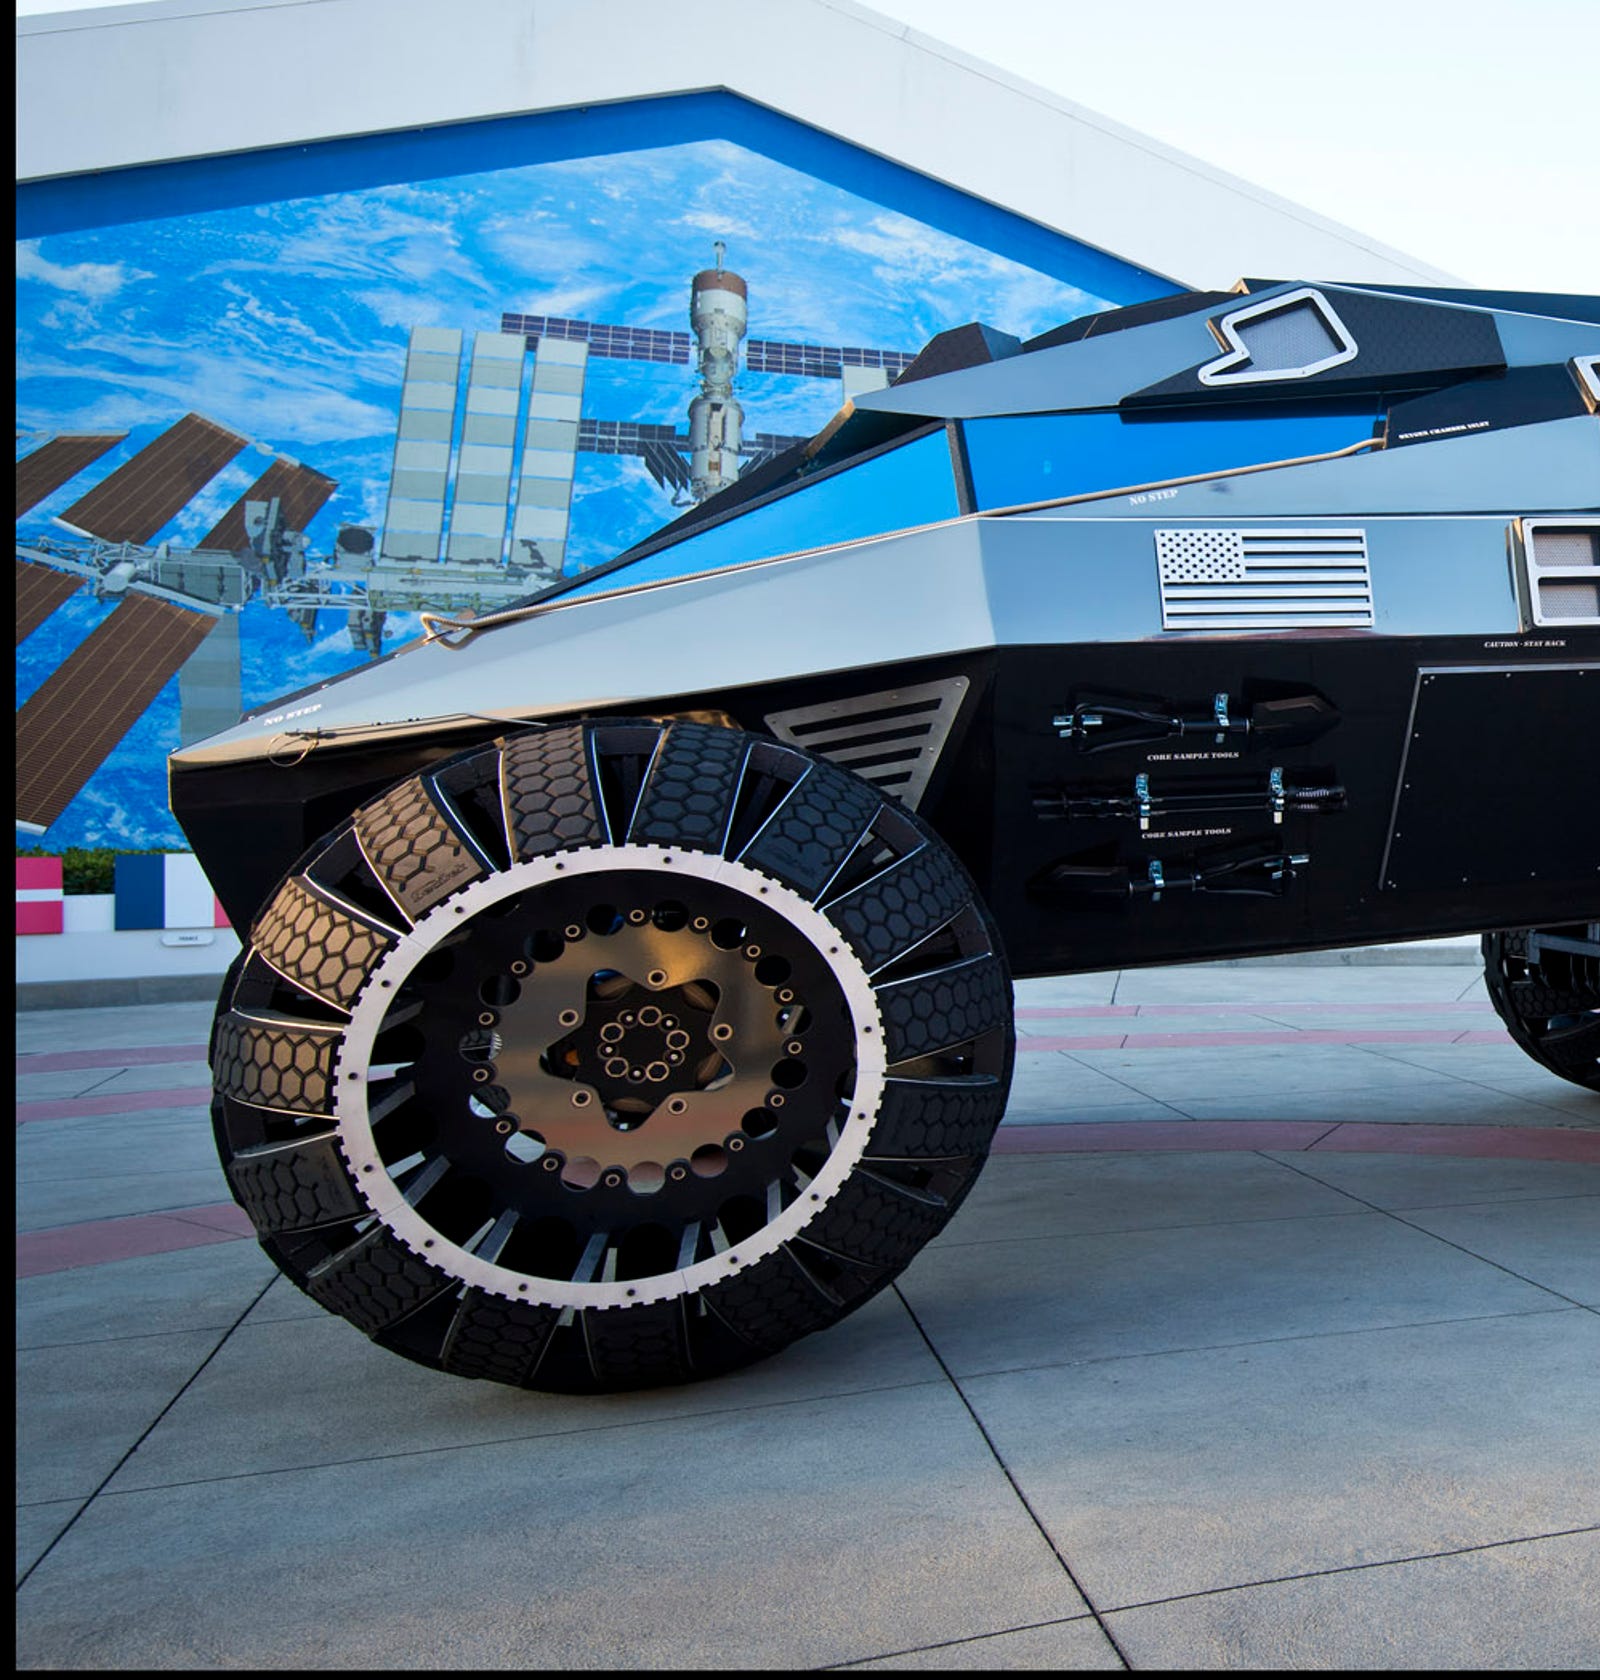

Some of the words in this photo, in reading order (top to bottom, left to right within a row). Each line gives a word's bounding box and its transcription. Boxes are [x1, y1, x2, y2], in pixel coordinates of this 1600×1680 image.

[1129, 495, 1146, 506] NO
[1148, 489, 1178, 501] STEP
[1484, 641, 1519, 649] CAUTION
[1523, 640, 1543, 648] STAY
[264, 715, 283, 726] NO
[286, 703, 322, 720] STEP
[1211, 751, 1240, 759] TOOLS
